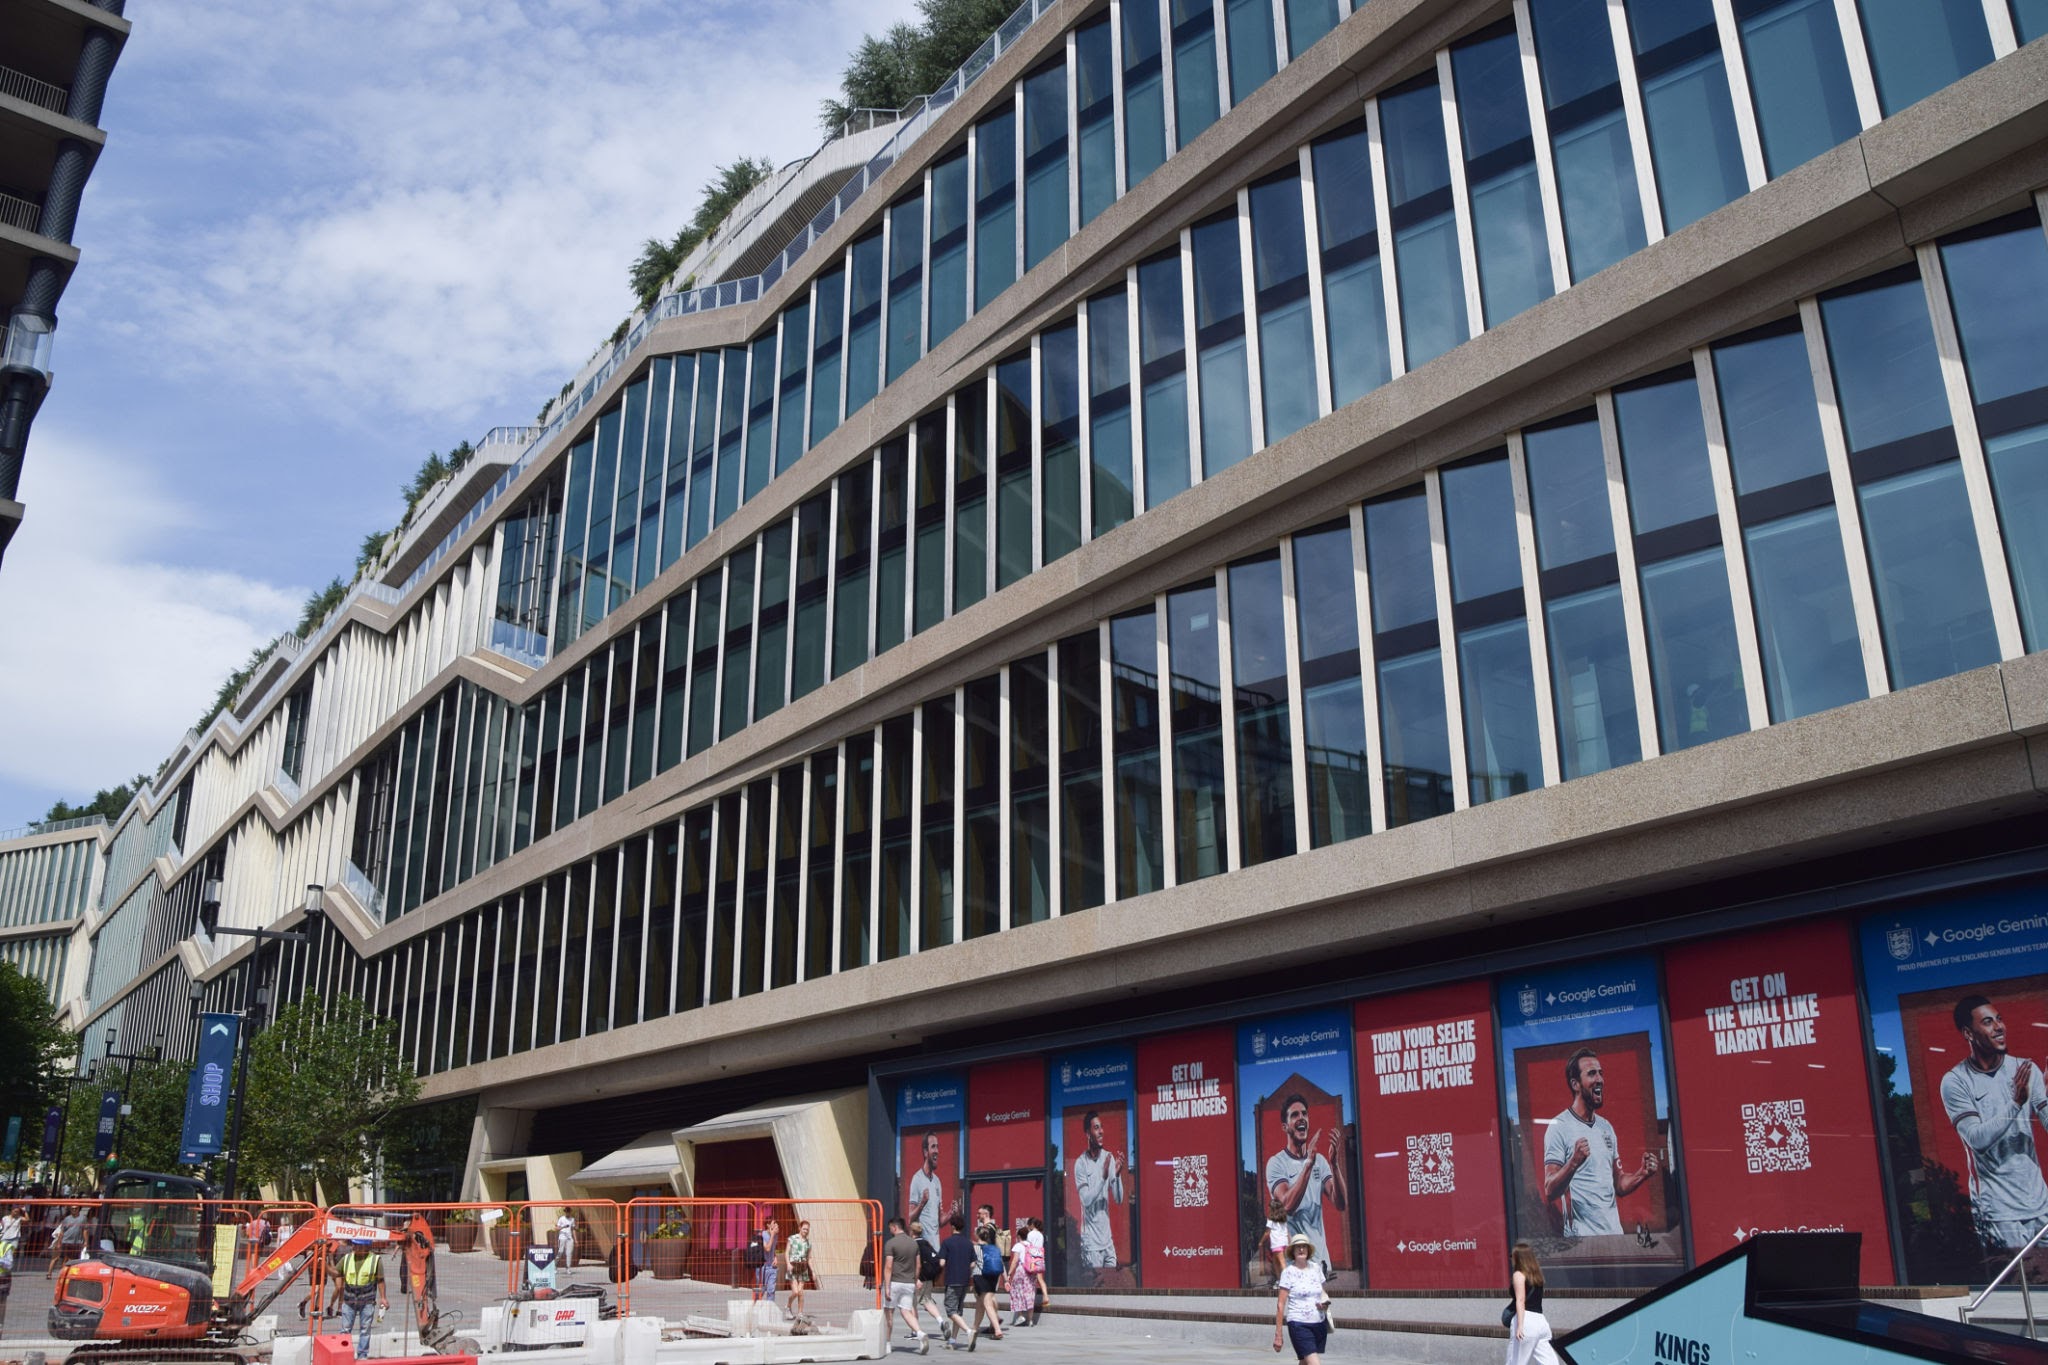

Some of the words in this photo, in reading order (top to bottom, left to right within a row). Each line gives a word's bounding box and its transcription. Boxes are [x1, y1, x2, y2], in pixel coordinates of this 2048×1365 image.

[1942, 923, 1996, 942] Google
[1897, 962, 1916, 972] PROUD
[1916, 959, 1942, 969] PARTNER
[1951, 956, 1961, 964] THE
[1962, 952, 1989, 961] ENGLAND
[1990, 949, 2011, 958] SENIOR
[1558, 988, 1596, 1003] Google
[1598, 980, 1636, 997] Gemini
[1730, 976, 1759, 1003] GET
[1763, 972, 1787, 998] ON
[1705, 1006, 1736, 1031] THE
[1737, 999, 1781, 1027] WALL
[1782, 993, 1820, 1021] LIKE
[1282, 1034, 1309, 1047] Google
[1311, 1028, 1339, 1041] Gemini
[1371, 1031, 1402, 1054] TURN
[1403, 1026, 1435, 1049] YOUR
[1436, 1019, 1476, 1044] SELFIE
[1714, 1026, 1767, 1055] HARRY
[1770, 1020, 1816, 1048] KANE
[1083, 1066, 1105, 1077] Google
[1106, 1061, 1128, 1074] Gemini
[1374, 1052, 1400, 1075] INTO
[1403, 1049, 1419, 1071] AN
[1421, 1042, 1476, 1068] ENGLAND
[1172, 1064, 1188, 1082] GET
[1190, 1062, 1203, 1080] ON
[1380, 1071, 1420, 1095] MURAL
[1422, 1064, 1473, 1090] PICTURE
[200, 1062, 223, 1106] SHOP
[940, 1088, 957, 1097] Gemini
[1157, 1084, 1174, 1102] THE
[1175, 1082, 1198, 1100] WALL
[1200, 1078, 1219, 1098] LIKE
[991, 1112, 1010, 1123] Google
[1011, 1109, 1030, 1119] Gemini
[1152, 1100, 1189, 1122] MORGAN
[1191, 1096, 1227, 1117] ROGERS
[335, 1226, 376, 1237] maylim
[1172, 1246, 1197, 1258] Google
[1198, 1245, 1223, 1256] Gemini
[1408, 1240, 1442, 1254] Google
[1443, 1239, 1477, 1251] Gemini
